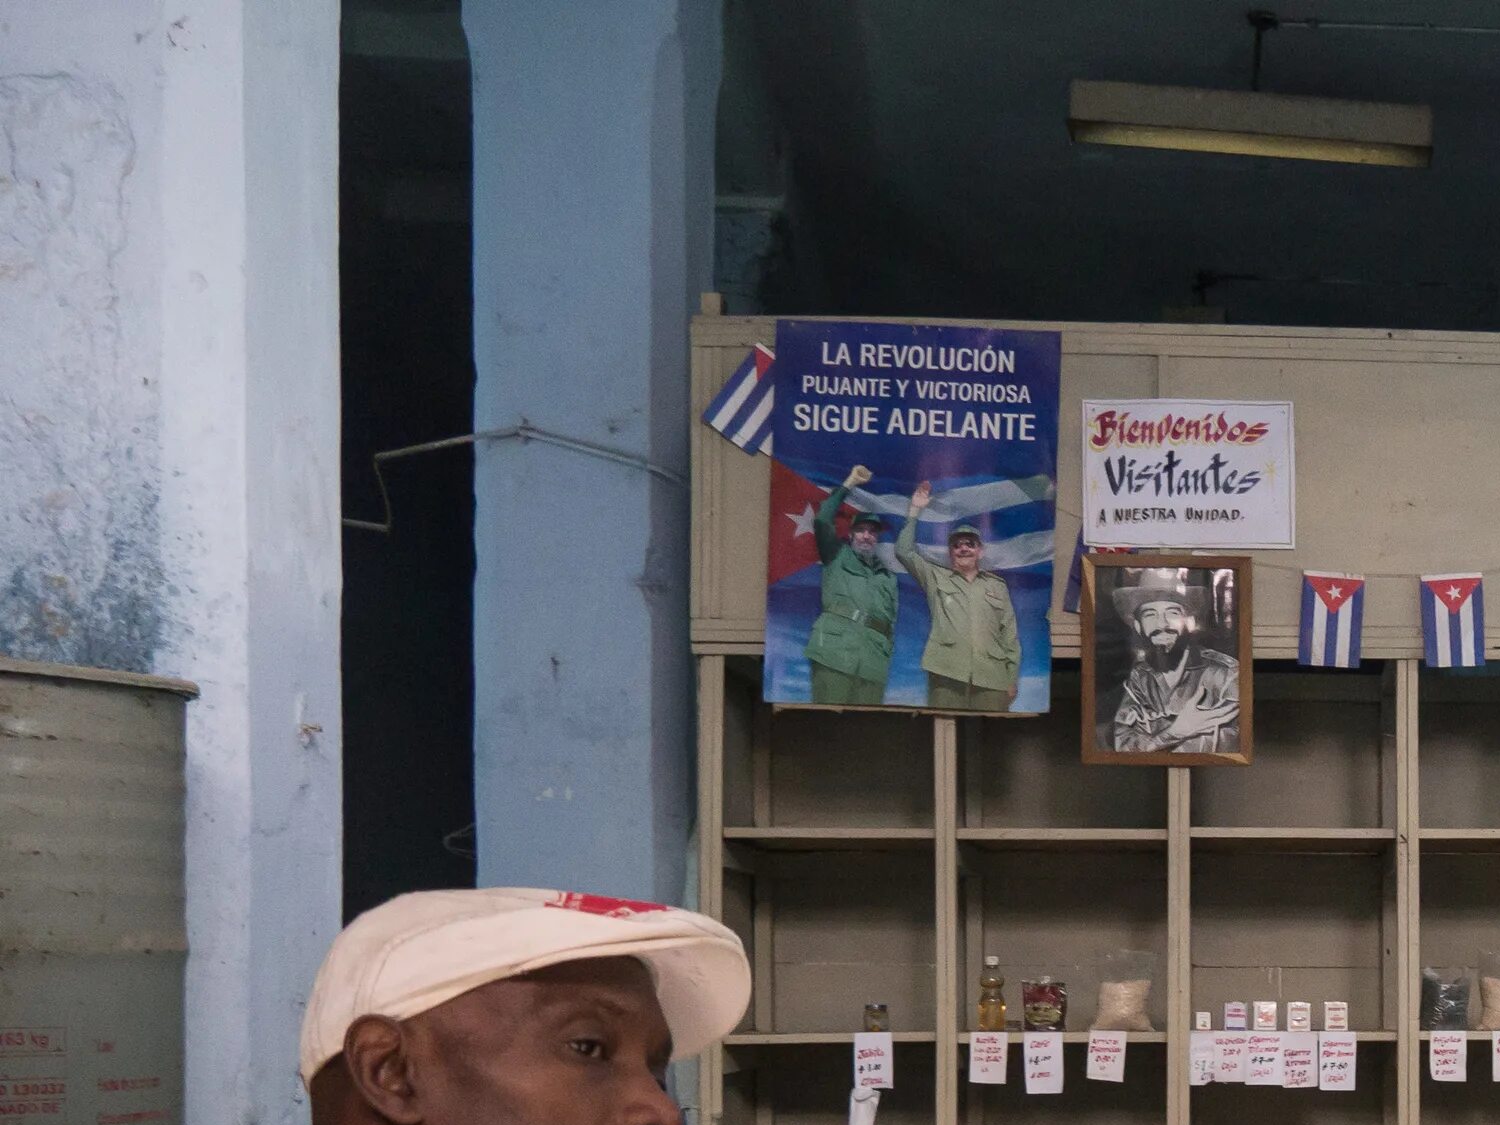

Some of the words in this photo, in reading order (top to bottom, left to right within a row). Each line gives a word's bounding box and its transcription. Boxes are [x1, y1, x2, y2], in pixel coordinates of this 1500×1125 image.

[821, 341, 852, 366] LA
[860, 343, 1015, 374] REVOLUCIÓN
[802, 375, 891, 398] PUJANTE
[896, 379, 909, 398] Y
[916, 380, 1032, 404] VICTORIOSA
[793, 403, 880, 434] SIGUE
[886, 407, 1036, 441] ADELANTE
[1090, 409, 1271, 448] Bienvenidos
[1103, 450, 1262, 498] Visitantes
[1099, 508, 1107, 524] A
[1114, 507, 1177, 523] NUESTRA
[1184, 507, 1246, 522] UNIDAD.
